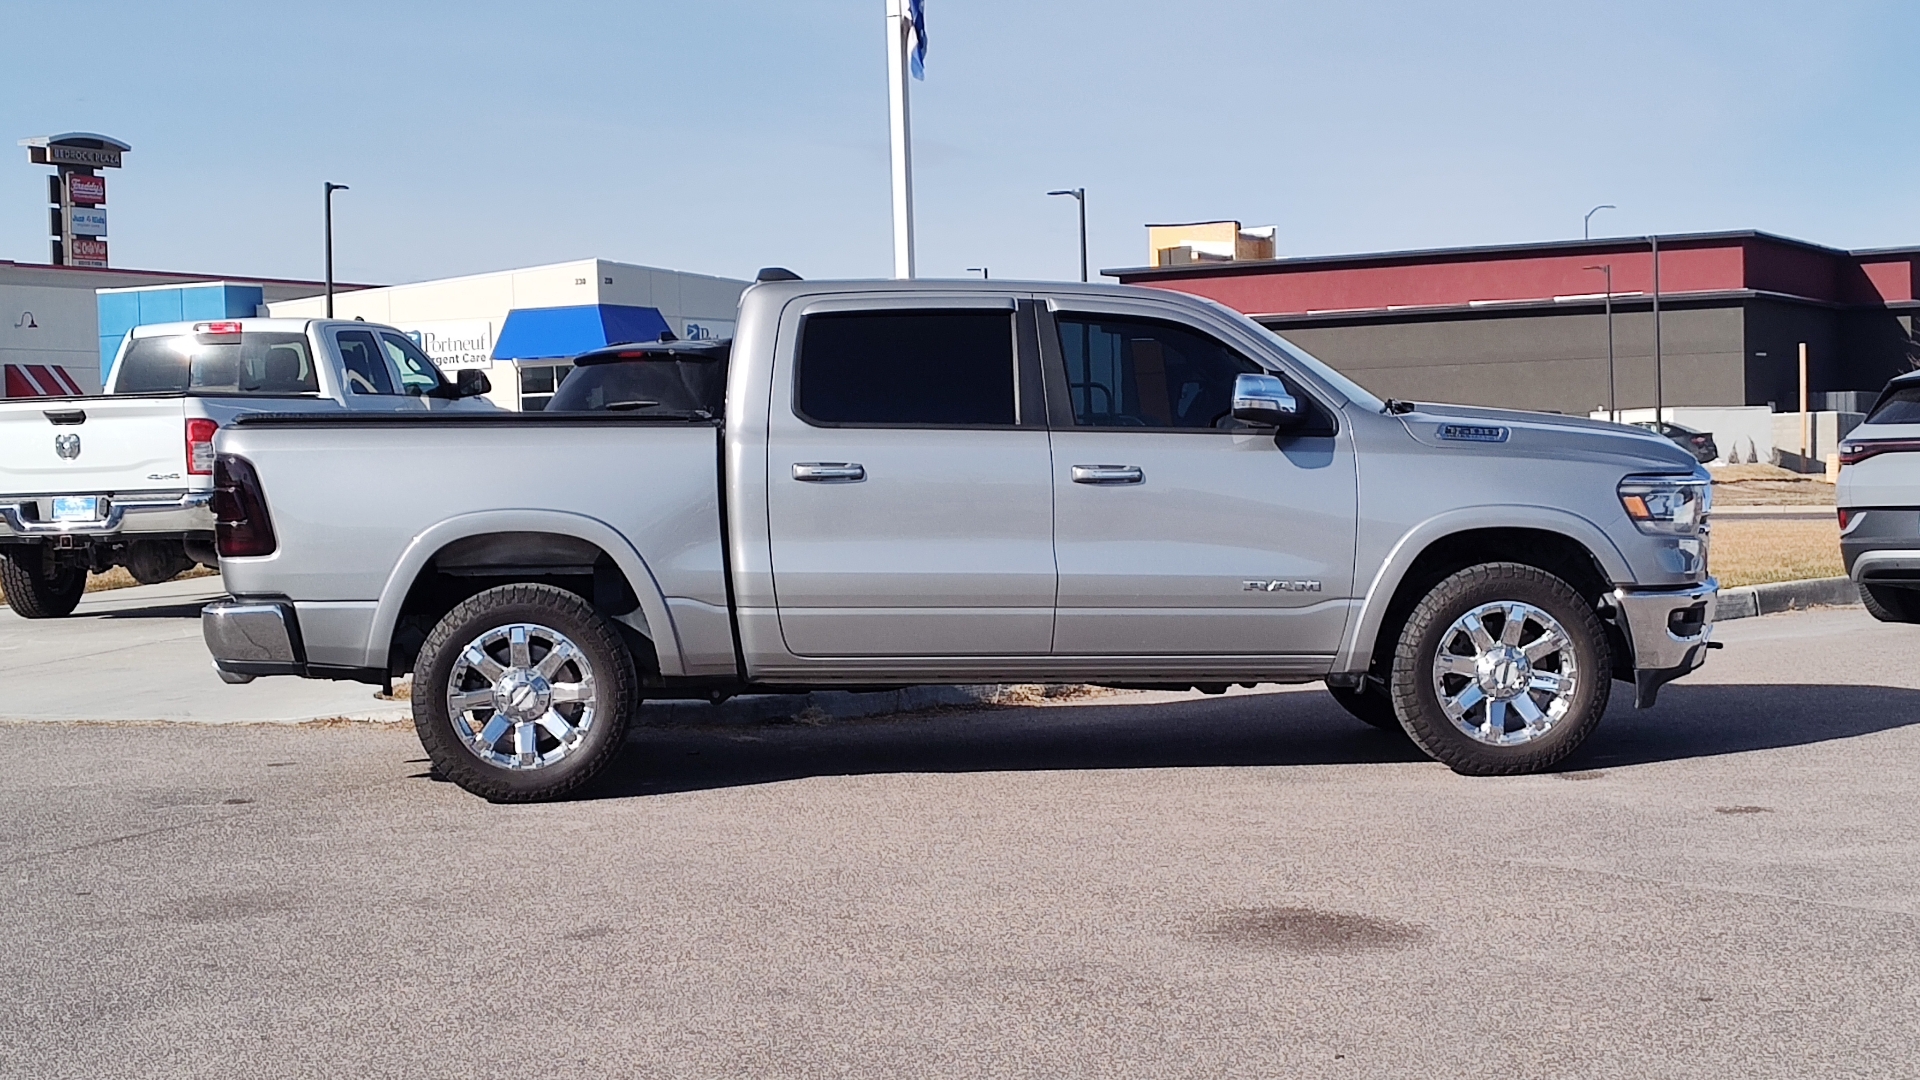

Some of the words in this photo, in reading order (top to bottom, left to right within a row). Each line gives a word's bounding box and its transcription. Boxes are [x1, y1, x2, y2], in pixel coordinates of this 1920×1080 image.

[54, 148, 94, 161] BEDROCK
[95, 151, 119, 163] PLAZA
[71, 178, 103, 193] Freddy's
[424, 332, 486, 353] Portneuf
[431, 354, 459, 367] rgent
[462, 352, 487, 363] Care
[1242, 579, 1321, 592] RAM
